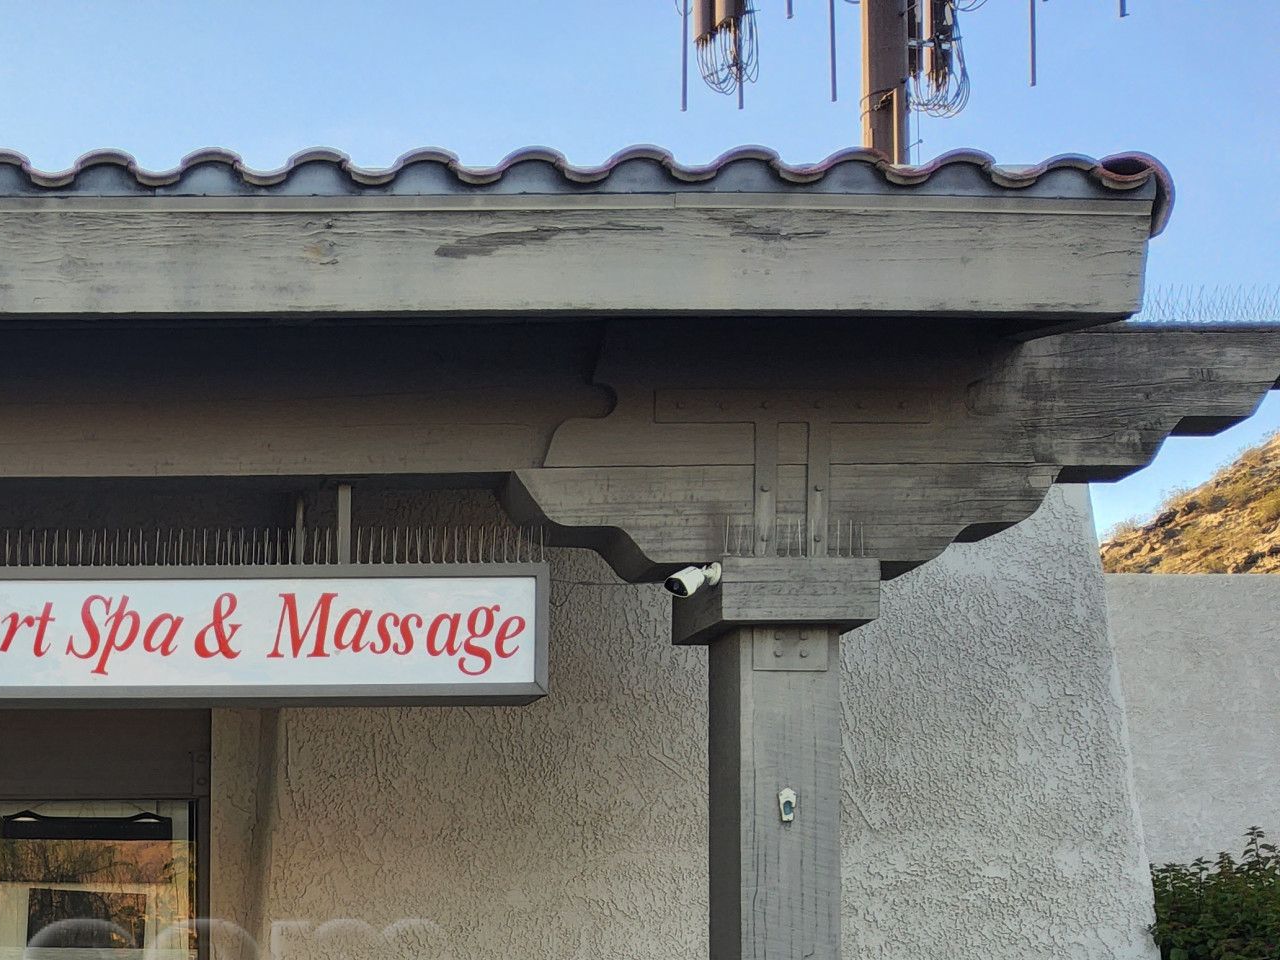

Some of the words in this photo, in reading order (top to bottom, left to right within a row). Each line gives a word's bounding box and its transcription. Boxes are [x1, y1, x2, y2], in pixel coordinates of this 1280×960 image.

[65, 594, 179, 676] Spa
[193, 592, 242, 660] &
[267, 591, 526, 677] Massage
